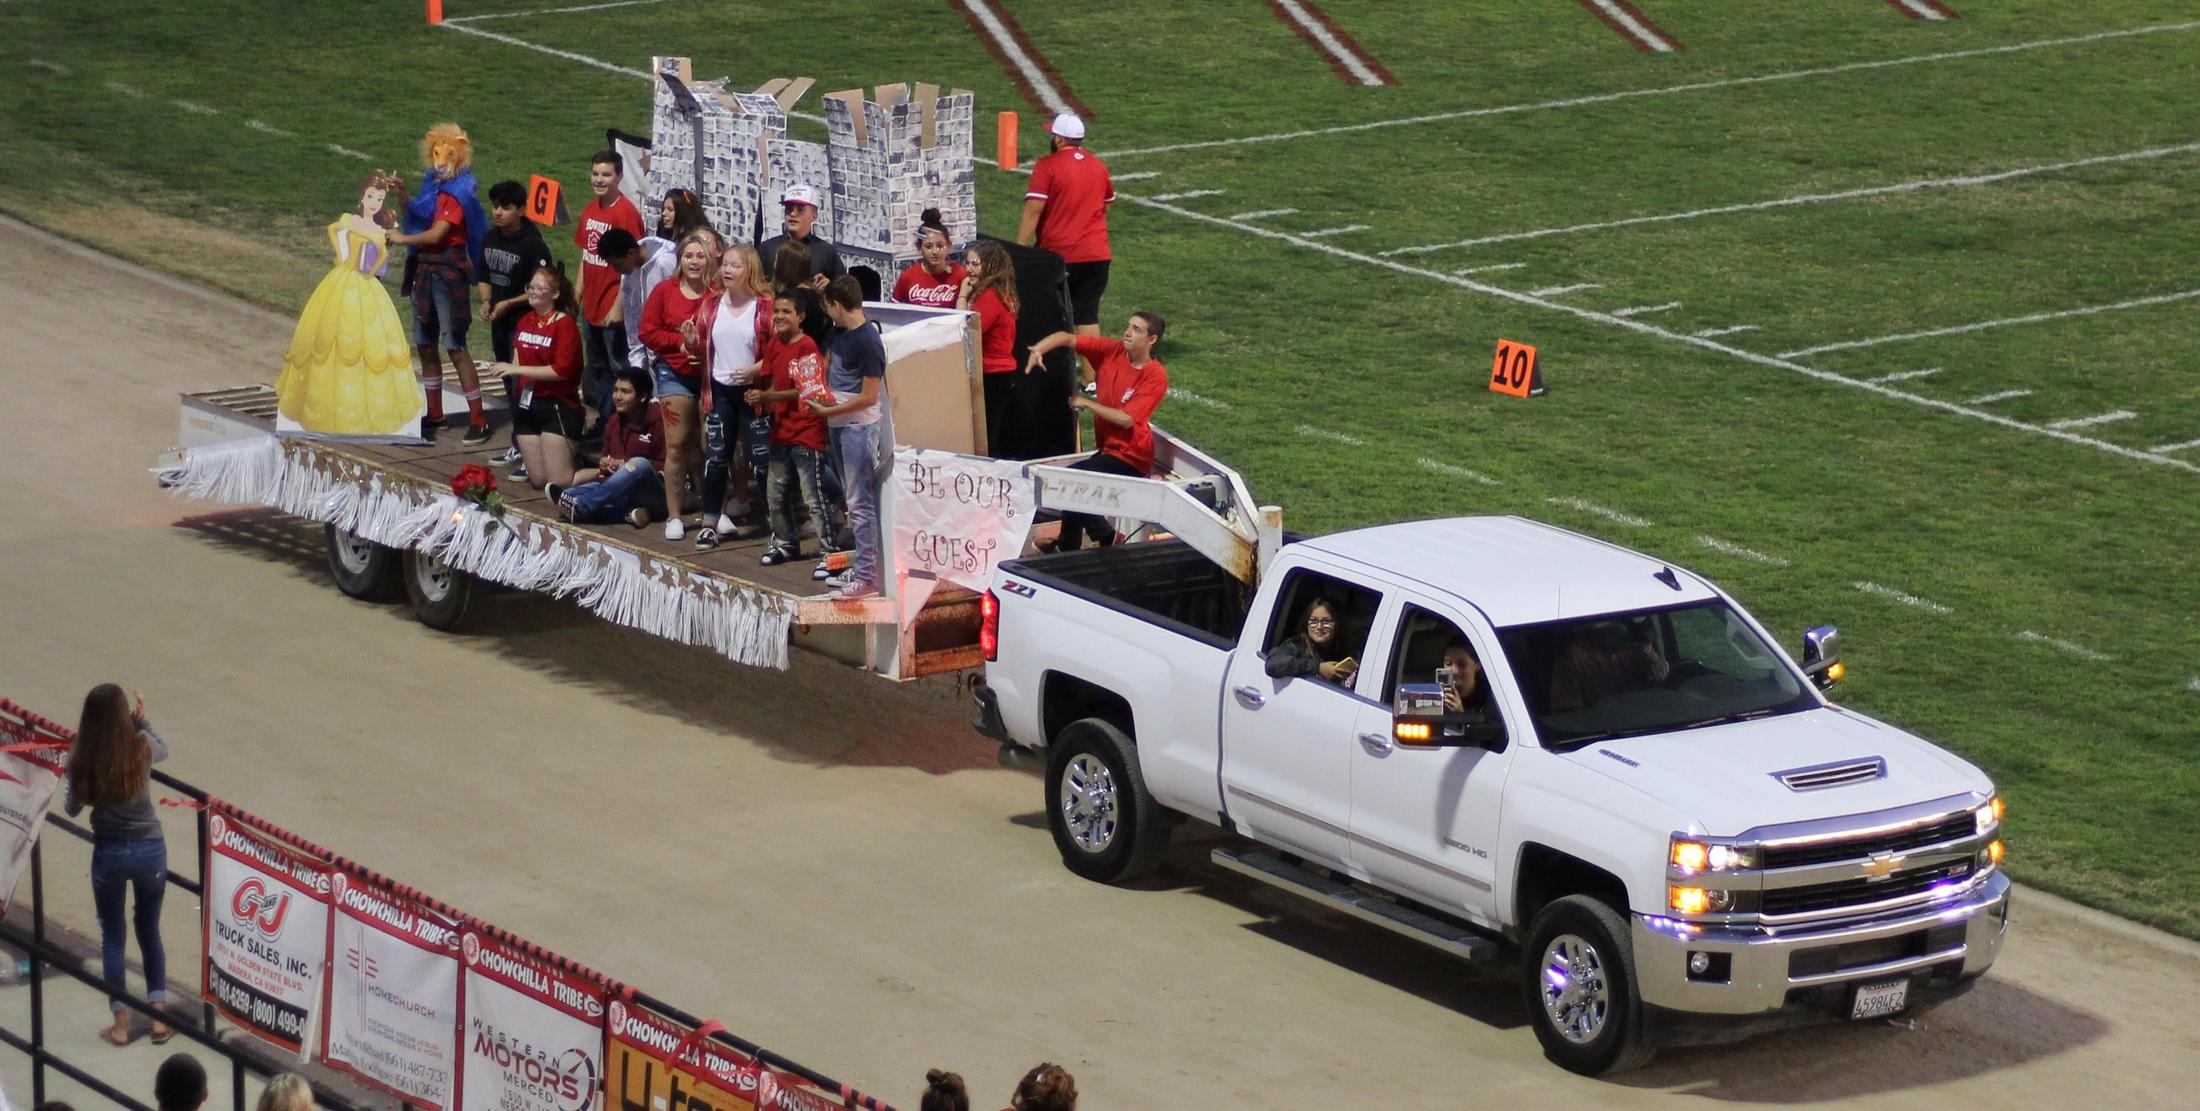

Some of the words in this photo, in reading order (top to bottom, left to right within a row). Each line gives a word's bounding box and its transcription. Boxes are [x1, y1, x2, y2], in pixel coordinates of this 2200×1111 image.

[534, 181, 549, 216] G
[908, 283, 958, 302] Coca-Cola
[1493, 344, 1528, 389] 10
[909, 459, 945, 499] BE
[954, 471, 1015, 518] OUR
[913, 530, 997, 576] GUEST
[224, 829, 289, 875] CHOWCHILLA
[291, 860, 320, 889] TRIBE
[344, 887, 413, 933] CHOWCHILLA
[414, 917, 446, 946] TRIBE
[215, 920, 245, 949] TRUCK
[247, 938, 284, 970] SALES,
[286, 957, 312, 980] INC.
[479, 948, 549, 996] CHOWCHILLA
[552, 980, 584, 1012] TRIBE
[473, 1016, 560, 1069] WESTERN
[473, 1032, 579, 1101] MOTORS
[502, 1071, 554, 1104] MERCED
